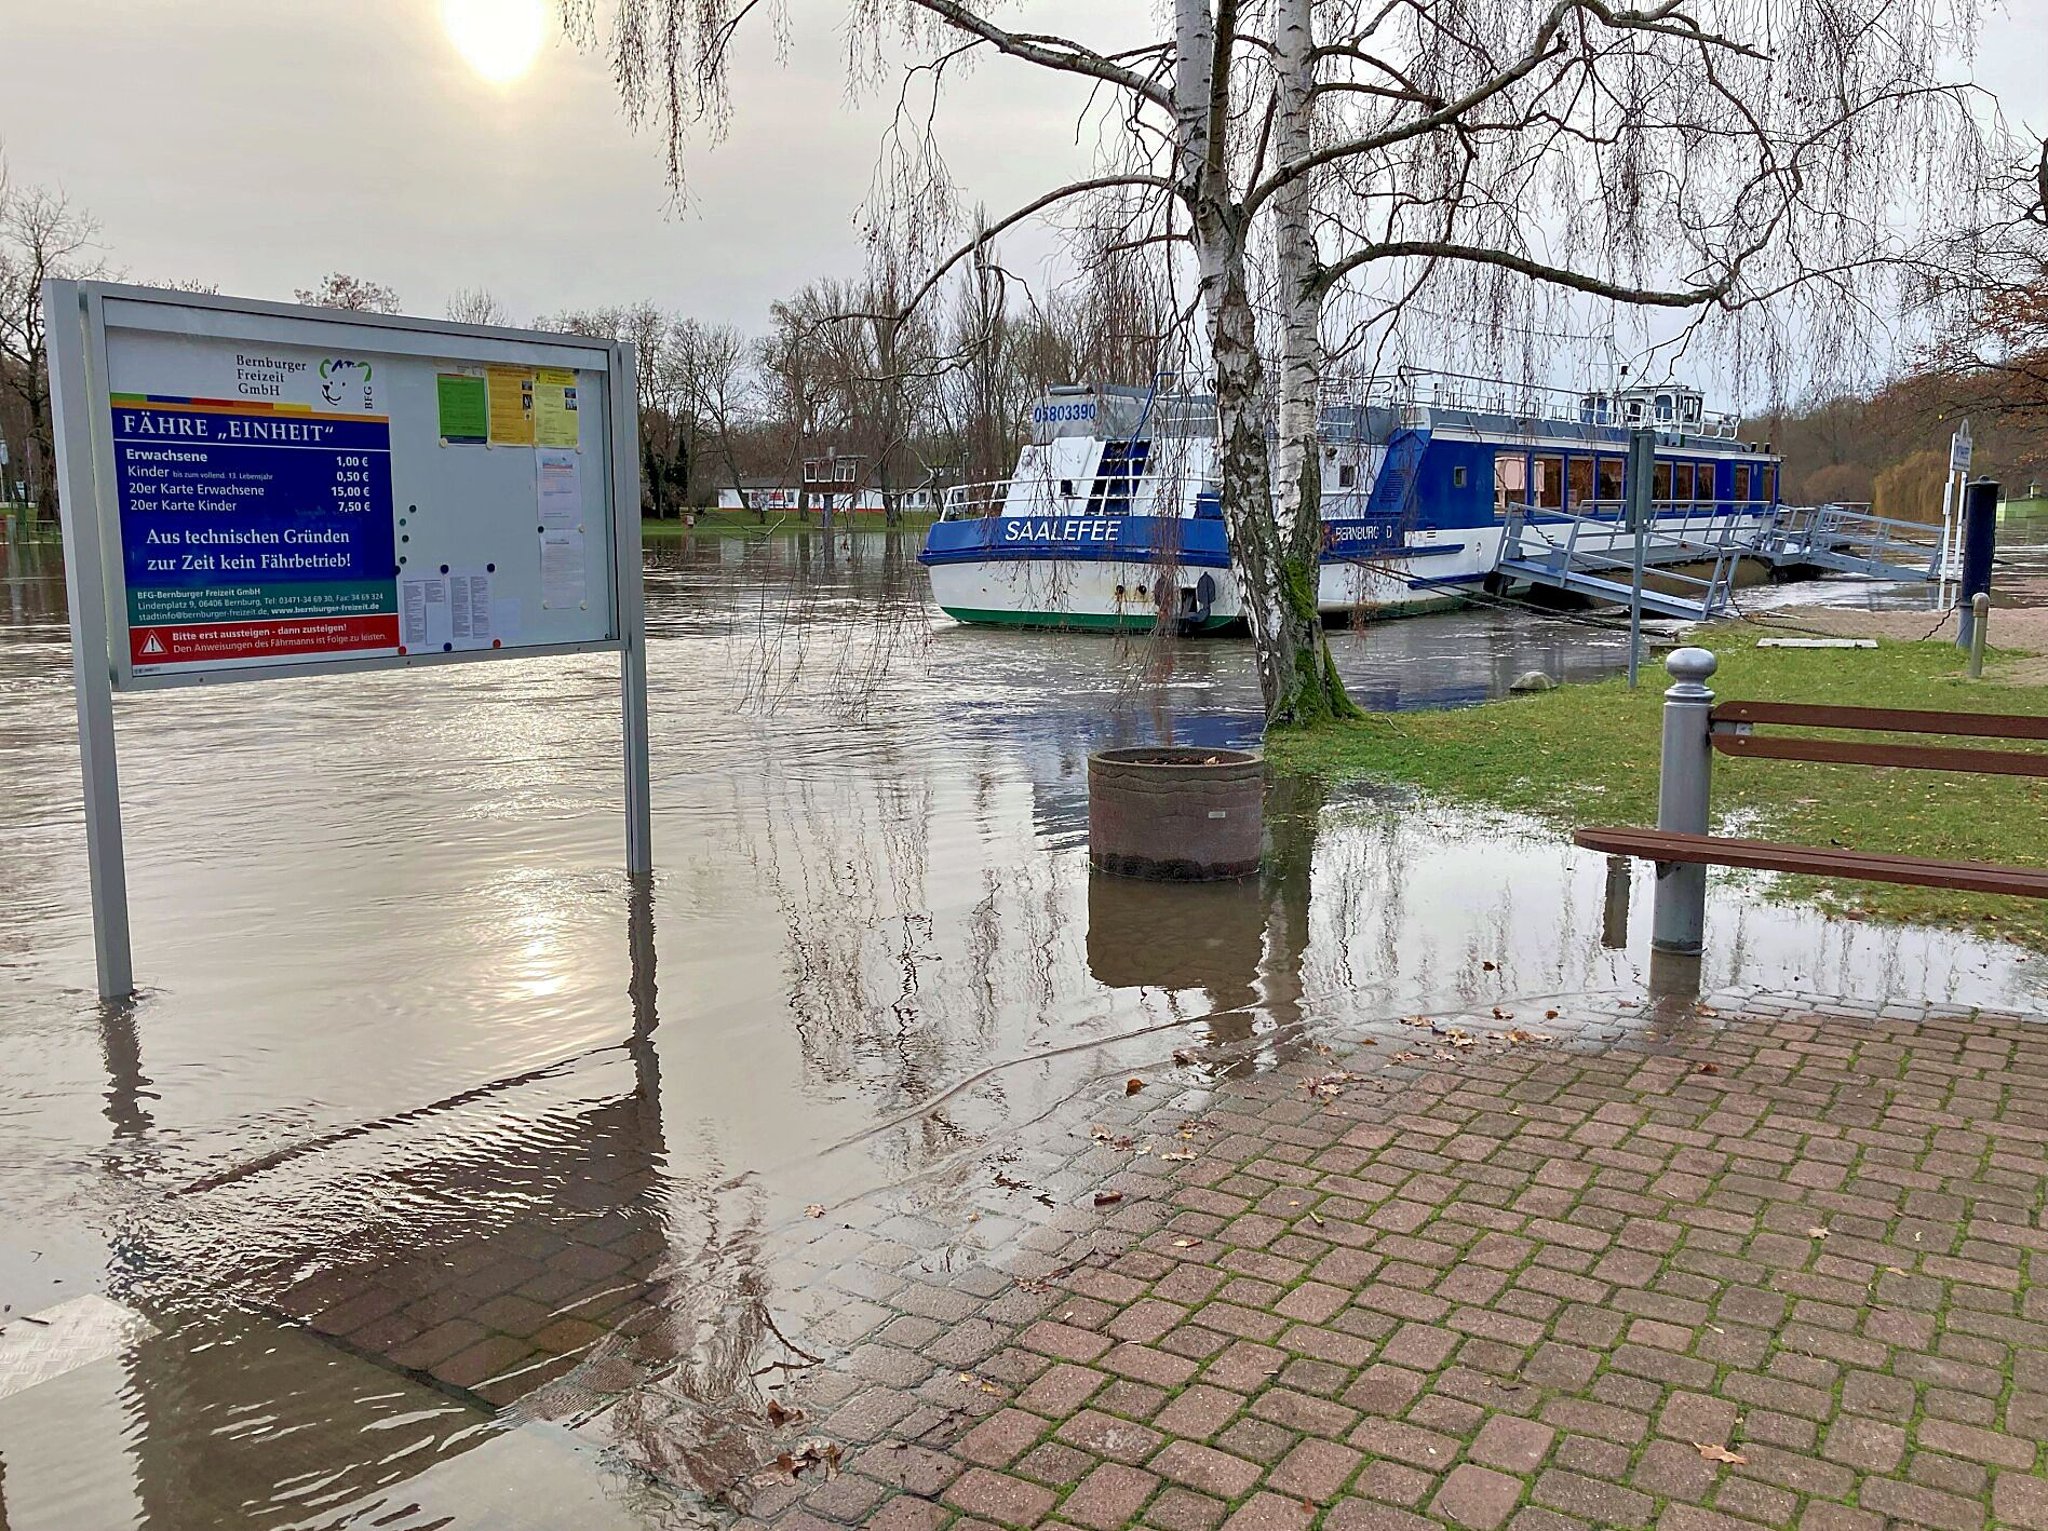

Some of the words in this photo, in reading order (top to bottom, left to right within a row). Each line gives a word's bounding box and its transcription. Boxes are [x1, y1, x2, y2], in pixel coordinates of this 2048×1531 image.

[236, 354, 307, 373] Bernburger
[237, 368, 285, 383] Freizeit
[238, 382, 280, 396] GmbH
[364, 386, 373, 409] BFG
[1034, 404, 1096, 422] 05803390
[122, 411, 208, 436] FÄHRE
[126, 448, 208, 462] Erwachsene
[336, 455, 359, 468] 1,00
[362, 457, 369, 467] €
[127, 465, 170, 477] Kinder
[336, 471, 359, 483] 0,50
[362, 472, 369, 482] €
[129, 482, 157, 494] 20er
[160, 483, 194, 495] Karte
[197, 484, 265, 496] Erwachsene
[331, 486, 359, 498] 15,00
[363, 487, 370, 497] €
[131, 499, 158, 511] 20er
[162, 500, 195, 511] Karte
[198, 500, 237, 512] Kinder
[338, 501, 360, 513] 7,50
[363, 502, 371, 512] €
[146, 530, 180, 544] Aus
[185, 529, 280, 544] technischen
[283, 528, 350, 543] Gründen
[1005, 520, 1121, 541] SAALEFEE
[1386, 525, 1392, 539] D
[147, 558, 177, 571] zur
[181, 555, 215, 570] Zeit
[220, 554, 255, 570] kein
[261, 553, 351, 569] Fährbetrieb!
[205, 588, 235, 597] Freizeit
[236, 587, 261, 596] GmbH
[138, 601, 187, 611] Lindenplatz
[271, 603, 380, 615] www.bernburger-freizeit.de
[172, 631, 197, 641] Bitte
[199, 630, 218, 639] erst
[220, 627, 270, 639] aussteigen
[278, 625, 300, 635] dann
[302, 623, 347, 634] zusteigen!
[173, 645, 192, 653] Den
[194, 641, 252, 652] Anweisungen
[255, 639, 269, 648] des
[271, 637, 314, 647] Fährmanns
[316, 636, 325, 645] ist
[327, 634, 349, 645] Folge
